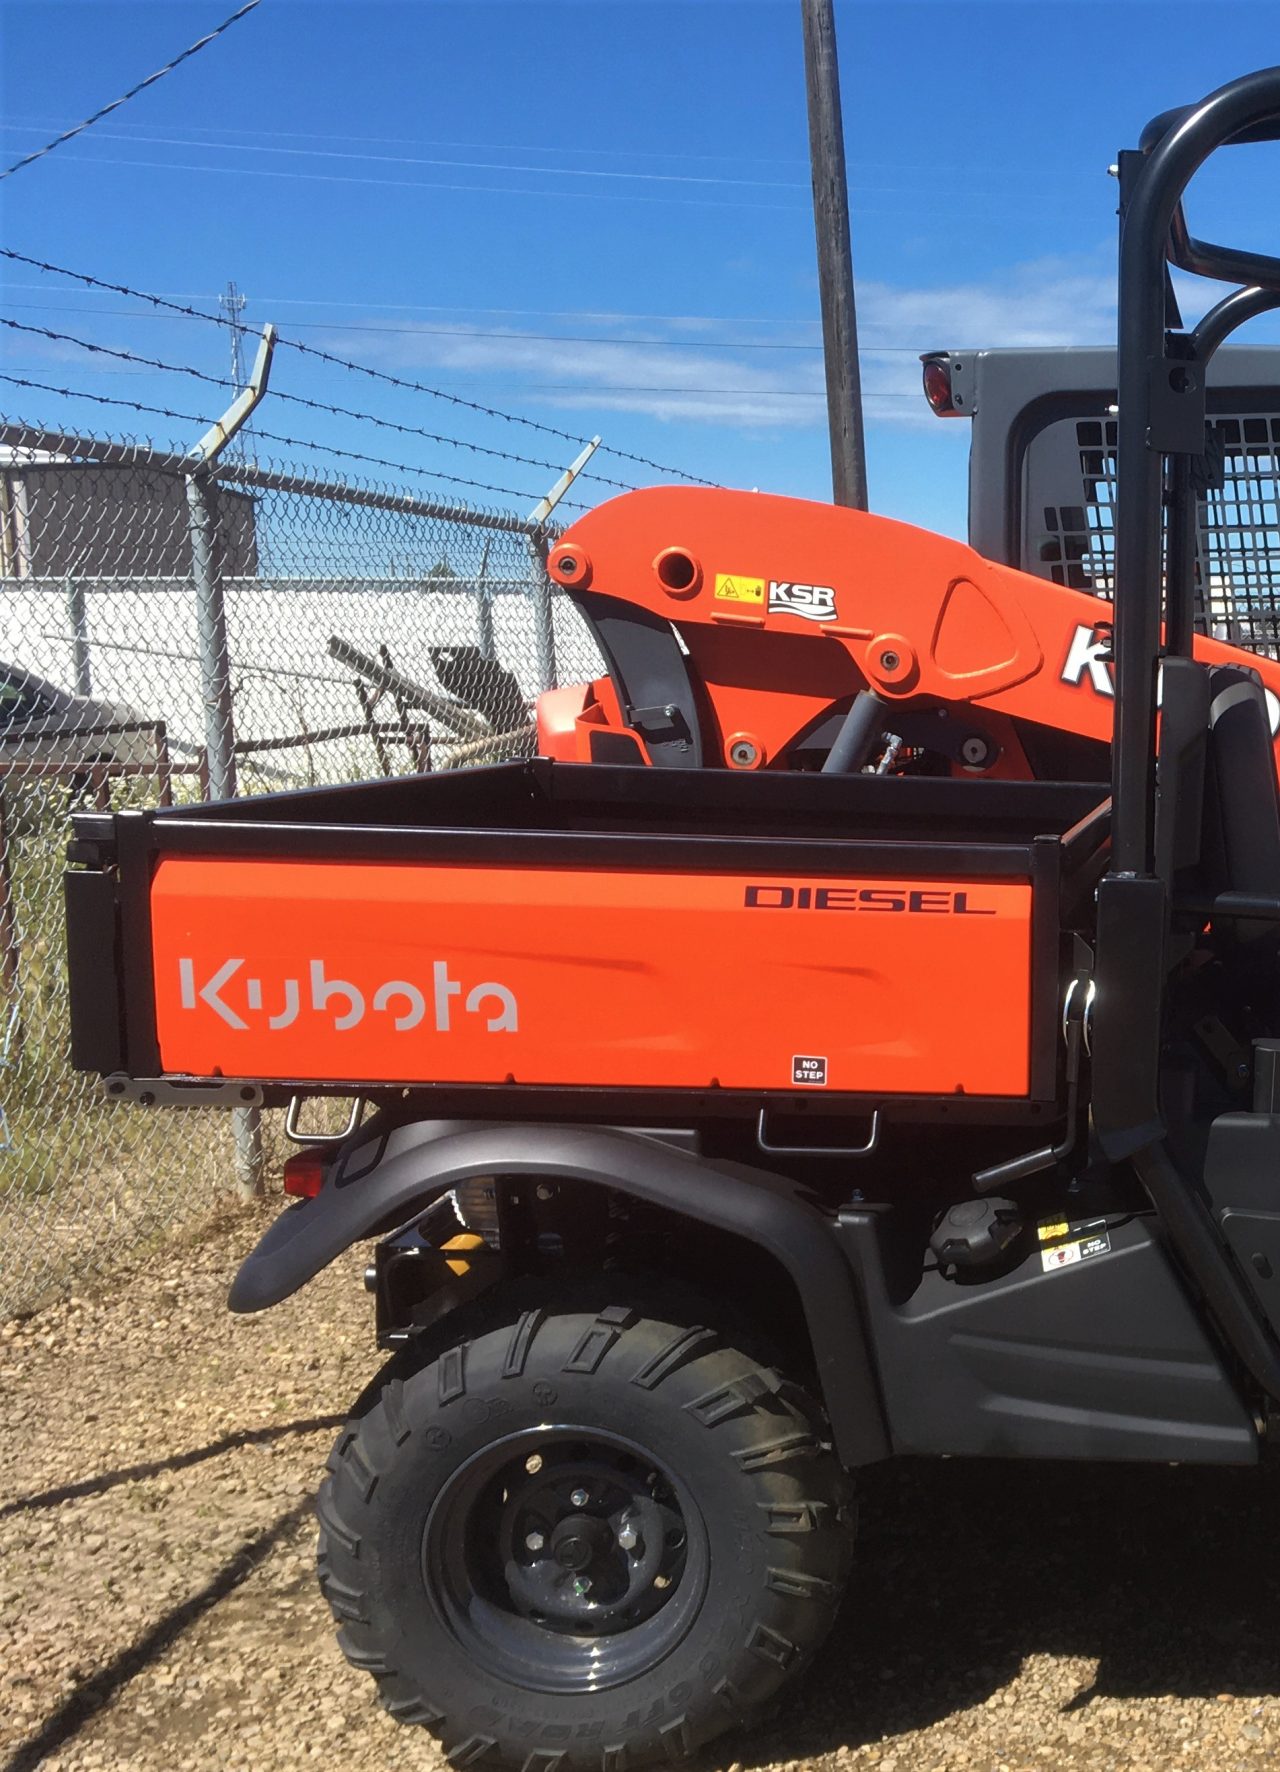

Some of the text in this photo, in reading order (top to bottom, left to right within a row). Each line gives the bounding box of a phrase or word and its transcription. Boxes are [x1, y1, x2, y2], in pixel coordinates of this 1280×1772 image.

[769, 581, 835, 607] KSR
[744, 885, 997, 915] DIESEL
[179, 958, 518, 1032] Kubota
[802, 1060, 818, 1069] NO
[795, 1070, 824, 1079] STEP
[1082, 1243, 1107, 1255] STEP
[1087, 1240, 1101, 1249] NO
